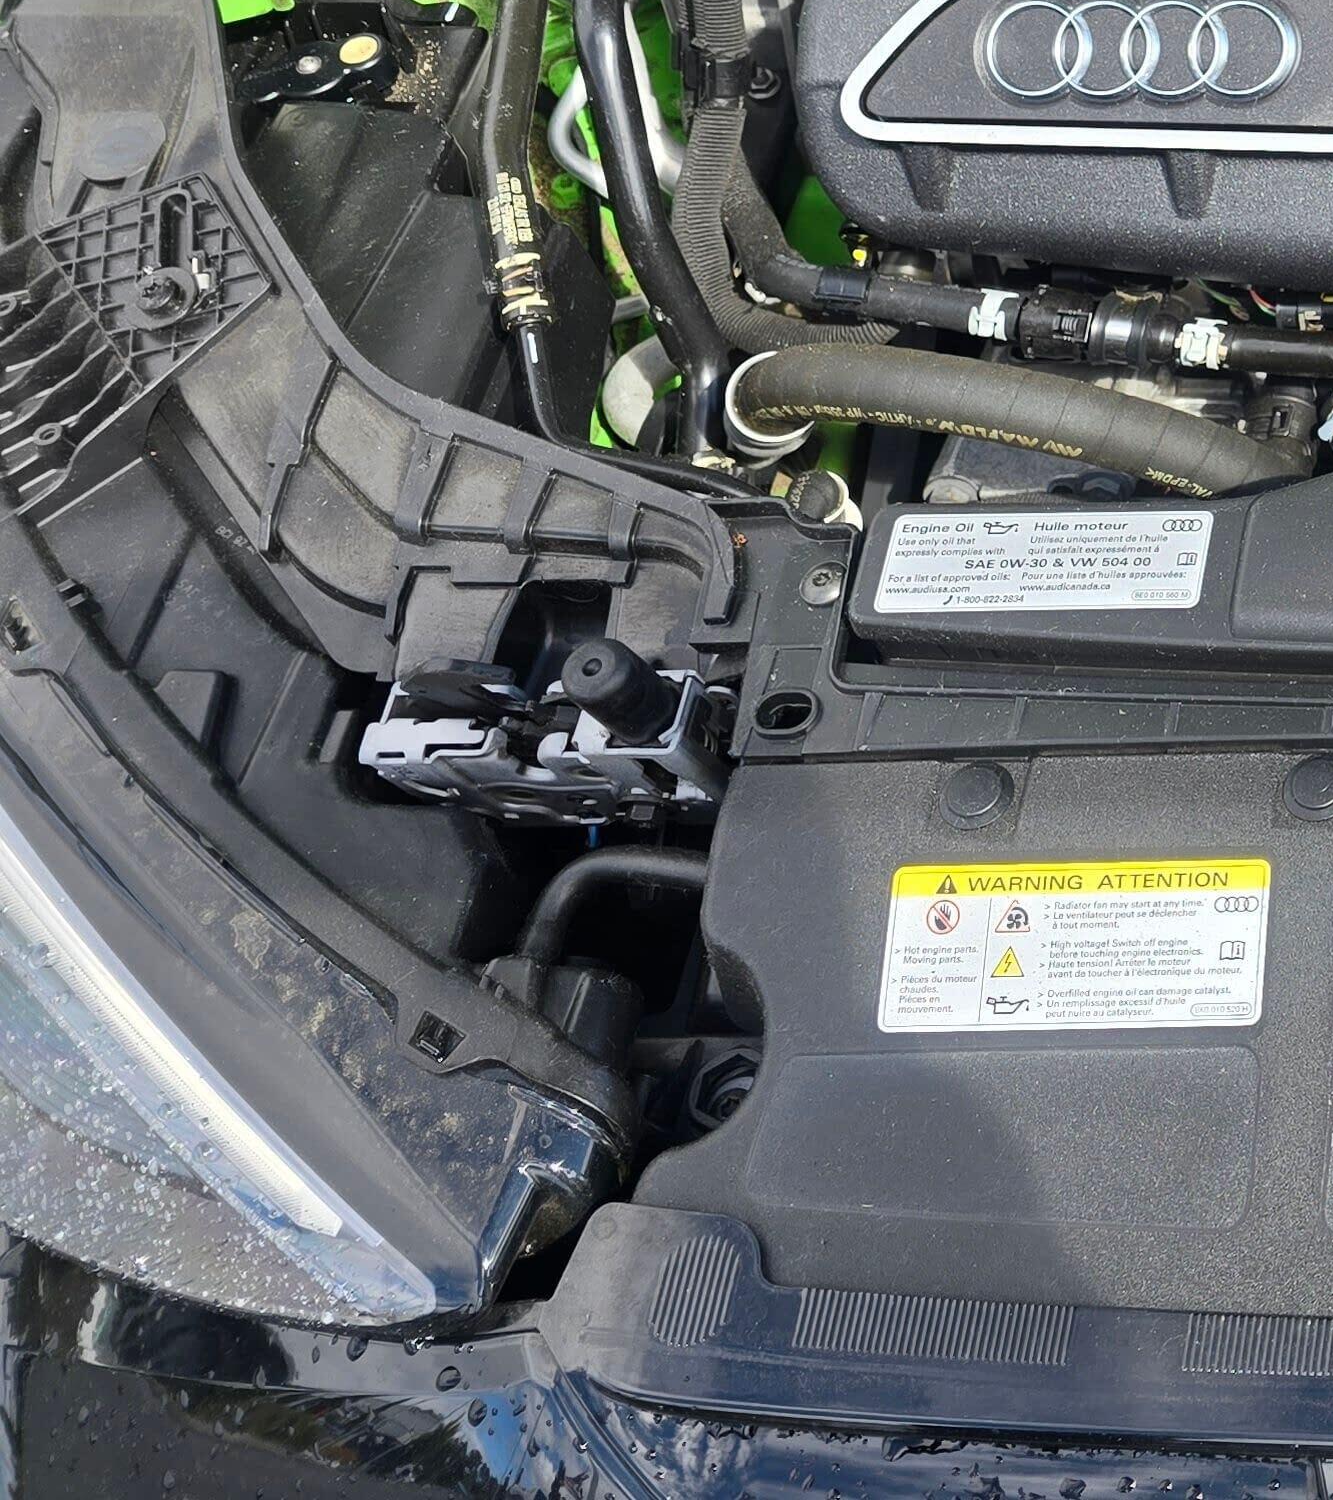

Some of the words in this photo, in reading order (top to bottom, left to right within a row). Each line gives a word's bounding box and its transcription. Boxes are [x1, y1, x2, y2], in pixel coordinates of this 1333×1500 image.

[902, 524, 950, 534] Engine
[955, 523, 974, 532] Oil
[1034, 522, 1069, 531] Huile
[919, 538, 938, 546] only
[1067, 535, 1122, 543] uniquement
[1140, 534, 1168, 542] l'huile
[895, 549, 939, 557] expressly
[941, 548, 986, 557] complies
[1028, 547, 1042, 555] qui
[1046, 546, 1082, 554] satisfait
[1085, 545, 1151, 554] expressément
[965, 560, 994, 569] SAE
[1000, 559, 1047, 568] 0W-30
[1053, 559, 1064, 567] &
[1071, 558, 1097, 566] VW
[1102, 558, 1128, 566] 504
[1133, 557, 1151, 566] 00
[943, 573, 988, 582] approved
[1022, 572, 1043, 580] Pour
[1067, 571, 1086, 579] liste
[1089, 571, 1125, 579] d'huiles
[1129, 571, 1186, 579] approuvées:
[885, 586, 970, 594] www.audiusa.com
[1020, 583, 1110, 591] www.audicanada.ca
[968, 876, 1083, 891] WARNING
[1097, 872, 1228, 889] ATTENTION
[1054, 901, 1091, 910] Radiator
[1093, 901, 1108, 909] fan
[1110, 902, 1131, 911] may
[1134, 900, 1152, 909] start
[1165, 901, 1180, 909] any
[1182, 899, 1204, 907] time.
[1053, 911, 1063, 920] Le
[1066, 910, 1112, 920] ventilateur
[1115, 911, 1134, 920] peut
[1149, 909, 1197, 918] déclencher
[1060, 921, 1077, 929] tout
[1080, 920, 1119, 929] moment.
[904, 946, 920, 954] Hot
[922, 946, 951, 954] engine
[954, 945, 979, 954] parts.
[1051, 941, 1071, 950] High
[1074, 940, 1109, 950] voltage!
[1112, 939, 1141, 948] Switch
[1144, 939, 1155, 947] off
[1158, 939, 1187, 948] engine
[1050, 950, 1078, 959] before
[1080, 949, 1119, 959] touching
[1121, 950, 1150, 958] engine
[1153, 947, 1203, 956] electronics.
[903, 956, 936, 965] Moving
[939, 955, 964, 965] parts.
[1049, 959, 1075, 970] Haute
[1077, 959, 1113, 969] tension!
[1148, 958, 1156, 966] le
[1158, 958, 1190, 966] moteur
[1048, 969, 1072, 979] avant
[1075, 970, 1085, 978] de
[1088, 968, 1121, 978] toucher
[1132, 967, 1191, 977] l'électronique
[1194, 967, 1205, 975] du
[1208, 967, 1242, 975] moteur.
[932, 975, 942, 983] du
[945, 975, 977, 983] moteur
[1048, 989, 1090, 998] Overfilled
[1093, 989, 1123, 999] engine
[1126, 989, 1137, 997] oil
[1140, 988, 1153, 996] can
[1156, 987, 1192, 996] damage
[1195, 985, 1231, 995] catalyst.
[1047, 1000, 1059, 1008] Un
[1062, 999, 1116, 1009] remplissage
[1119, 998, 1153, 1006] excessif
[1155, 997, 1185, 1005] d'huile
[898, 1005, 953, 1013] mouvement.
[1046, 1009, 1066, 1019] peut
[1068, 1009, 1090, 1018] nuire
[1106, 1008, 1153, 1017] catalyseur.
